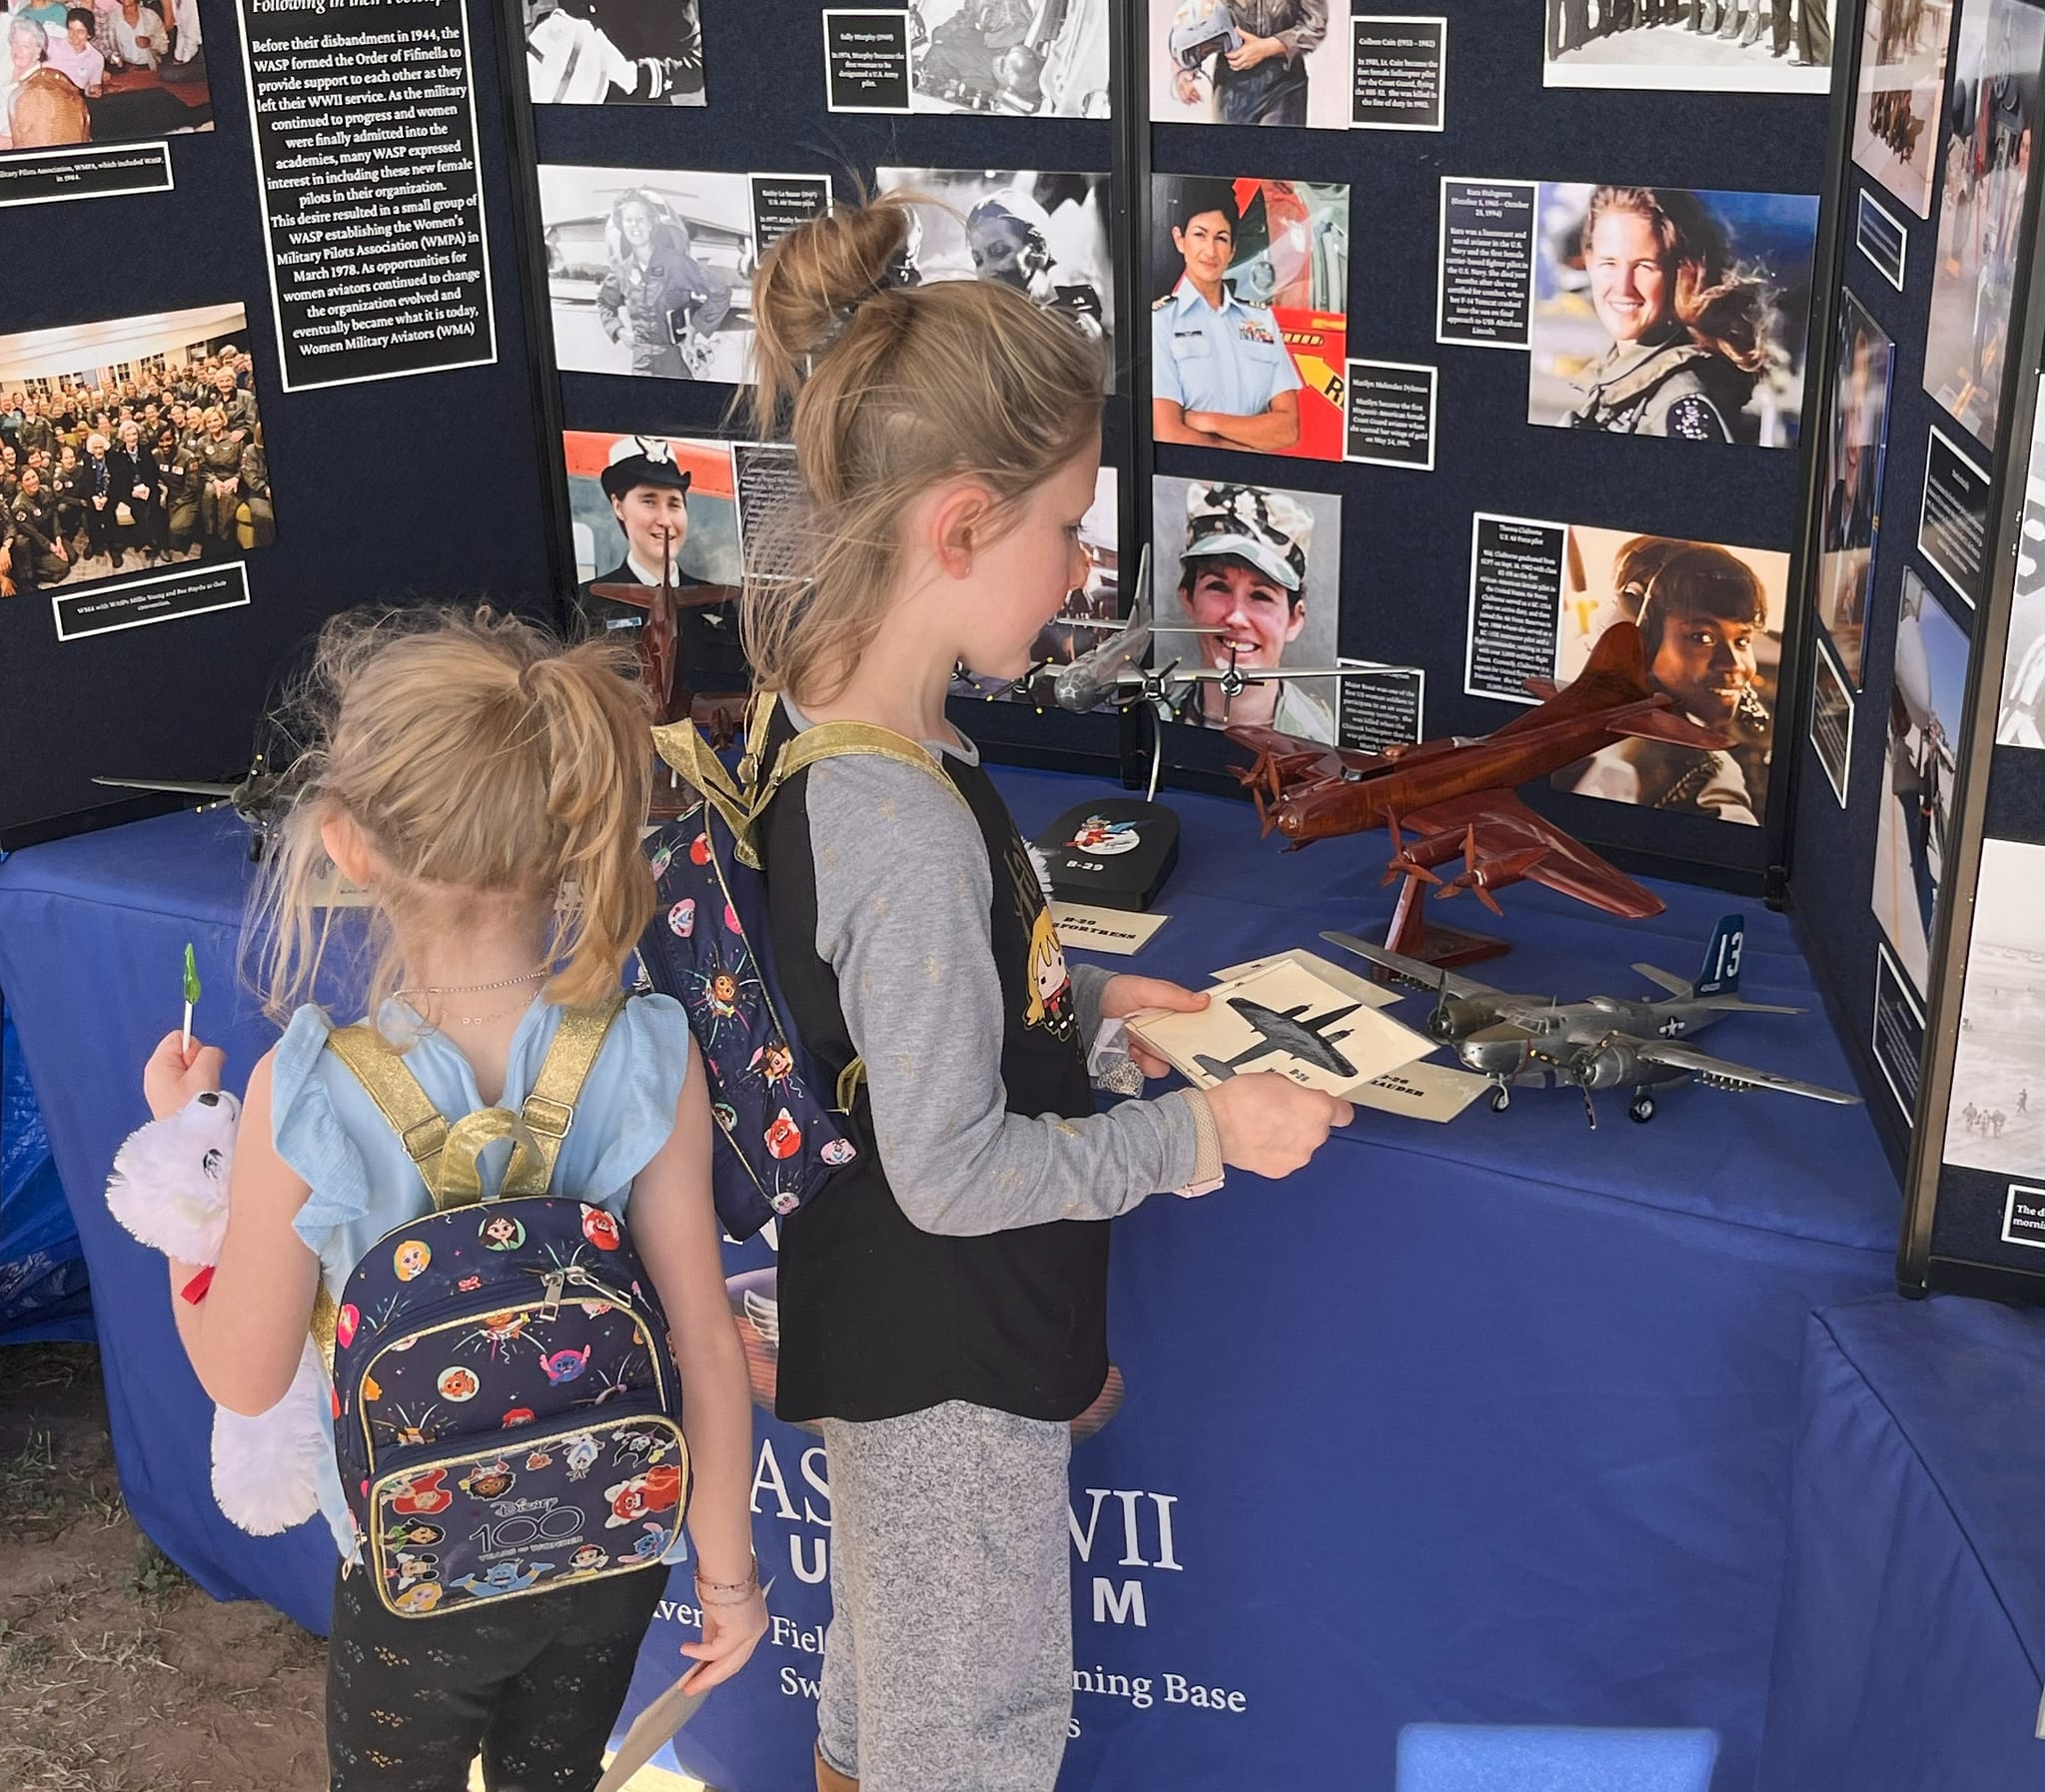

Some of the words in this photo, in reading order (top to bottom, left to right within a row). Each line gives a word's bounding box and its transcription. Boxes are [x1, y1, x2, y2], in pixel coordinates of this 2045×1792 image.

[252, 38, 289, 52] Before
[291, 36, 319, 50] their
[321, 32, 396, 48] disbandment
[398, 30, 409, 42] in
[411, 29, 440, 41] 1944,
[441, 26, 460, 39] the
[254, 59, 290, 72] WASP
[292, 54, 333, 69] formed
[335, 53, 354, 66] the
[356, 51, 389, 65] Order
[390, 49, 402, 62] of
[404, 46, 449, 61] Fifinella
[450, 48, 462, 58] to
[258, 77, 302, 94] provide
[304, 76, 349, 91] support
[351, 75, 363, 85] to
[364, 70, 391, 84] each
[392, 68, 422, 81] other
[424, 70, 437, 79] as
[438, 65, 462, 80] they
[257, 98, 277, 111] left
[279, 97, 306, 110] their
[308, 94, 343, 107] WWII
[345, 91, 387, 105] service.
[389, 90, 403, 101] As
[404, 87, 423, 99] the
[424, 85, 467, 98] military
[272, 113, 330, 130] continued
[331, 116, 343, 125] to
[345, 112, 392, 127] progress
[394, 106, 416, 119] and
[417, 106, 458, 117] women
[286, 138, 314, 148] were
[316, 131, 351, 147] finally
[354, 126, 404, 142] admitted
[406, 126, 429, 138] into
[430, 123, 448, 135] the
[276, 153, 339, 169] academies,
[340, 152, 372, 164] many
[373, 146, 407, 159] WASP
[409, 140, 462, 159] expressed
[267, 177, 311, 189] interest
[312, 173, 324, 185] in
[326, 168, 380, 184] including
[381, 165, 410, 178] these
[412, 165, 436, 175] new
[437, 158, 473, 172] female
[299, 192, 332, 209] pilots
[333, 190, 345, 202] in
[347, 187, 374, 201] their
[375, 181, 447, 200] organization.
[271, 214, 296, 227] This
[297, 211, 331, 224] desire
[333, 204, 378, 221] resulted
[380, 205, 391, 216] in
[402, 199, 431, 213] small
[433, 199, 465, 213] group
[466, 194, 480, 206] of
[289, 231, 323, 244] WASP
[325, 224, 393, 241] establishing
[394, 220, 412, 233] the
[413, 214, 464, 230] Women's
[277, 251, 322, 265] Military
[323, 247, 355, 260] Pilots
[357, 239, 419, 256] Association
[421, 232, 466, 251] (WMPA)
[468, 232, 479, 243] in
[294, 267, 330, 281] March
[331, 265, 360, 277] 1978.
[362, 264, 375, 274] As
[377, 254, 450, 275] opportunities
[452, 251, 467, 263] for
[283, 290, 325, 301] women
[327, 284, 371, 296] aviators
[373, 273, 428, 291] continued
[430, 275, 441, 284] to
[442, 270, 480, 283] change
[307, 305, 326, 317] the
[327, 298, 397, 317] organization
[398, 290, 439, 306] evolved
[441, 287, 462, 301] and
[293, 321, 350, 339] eventually
[352, 318, 394, 331] became
[395, 312, 424, 324] what
[425, 310, 434, 321] it
[436, 309, 445, 320] is
[446, 305, 479, 319] today,
[300, 343, 344, 355] Women
[345, 336, 389, 350] Military
[391, 330, 435, 344] Aviators
[437, 322, 475, 340] (WMA)
[1714, 932, 1744, 981] 13
[2013, 1219, 2045, 1231] morni
[2017, 1205, 2037, 1216] The
[491, 1497, 559, 1517] Disney
[470, 1505, 585, 1553] 100
[771, 1615, 826, 1654] Fiel
[1072, 1665, 1153, 1709] ning
[1162, 1673, 1248, 1713] Base
